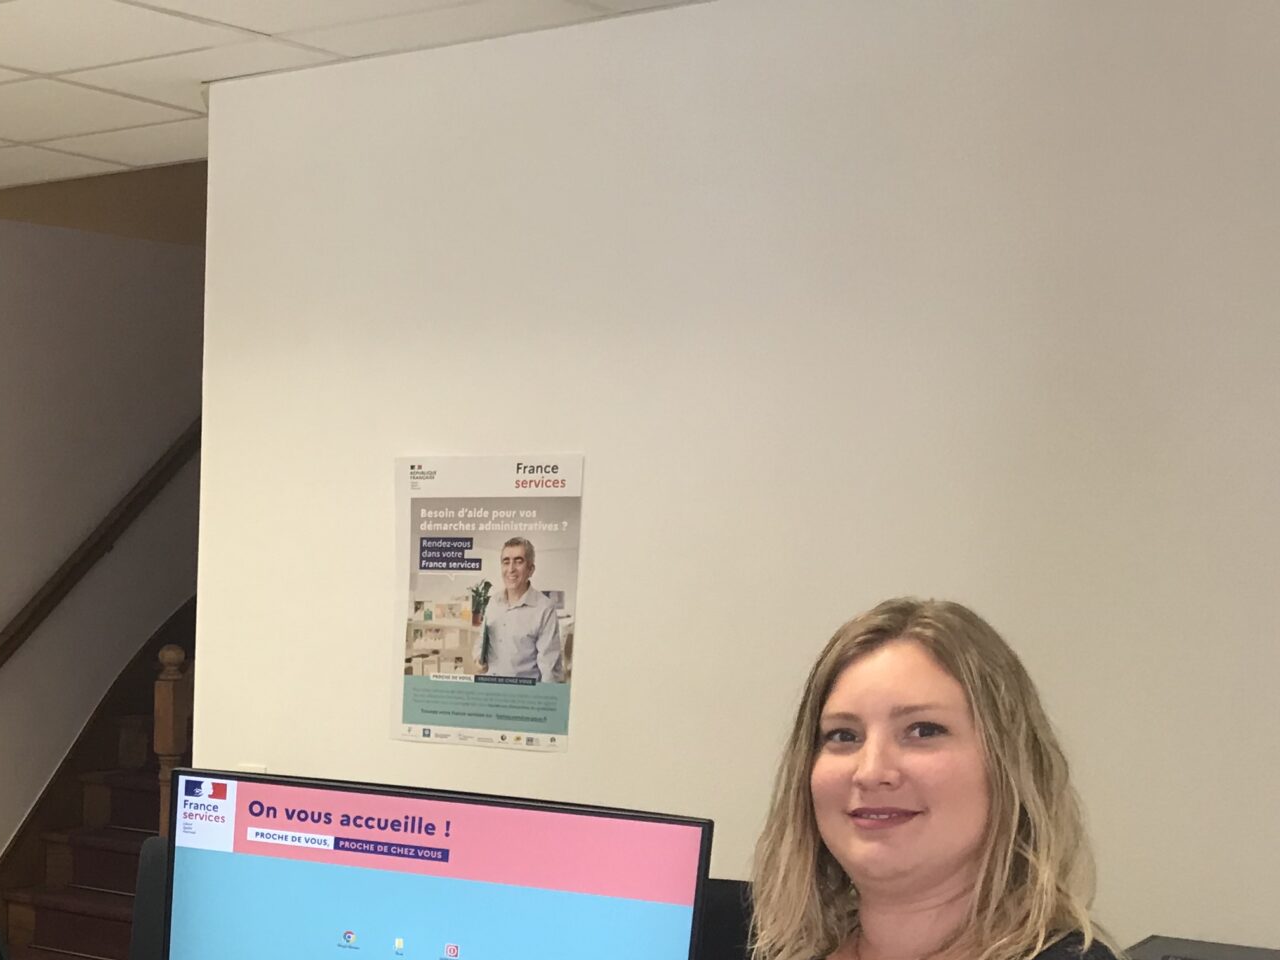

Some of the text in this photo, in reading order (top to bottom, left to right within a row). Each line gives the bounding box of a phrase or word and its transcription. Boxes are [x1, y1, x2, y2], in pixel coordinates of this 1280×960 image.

[516, 462, 559, 474] France
[515, 476, 567, 489] services
[420, 508, 537, 520] Besoin d'aide pour vos
[420, 521, 568, 531] démarches administratives ?
[422, 540, 471, 548] Rendez-vous
[422, 550, 440, 558] dans
[421, 560, 480, 569] France services
[183, 799, 218, 812] France
[183, 811, 225, 823] services
[248, 800, 451, 837] On vous accueille !
[255, 831, 330, 847] PROCHE DE VOUS,
[339, 840, 442, 859] PROCHE DE CHEZ VOUS
